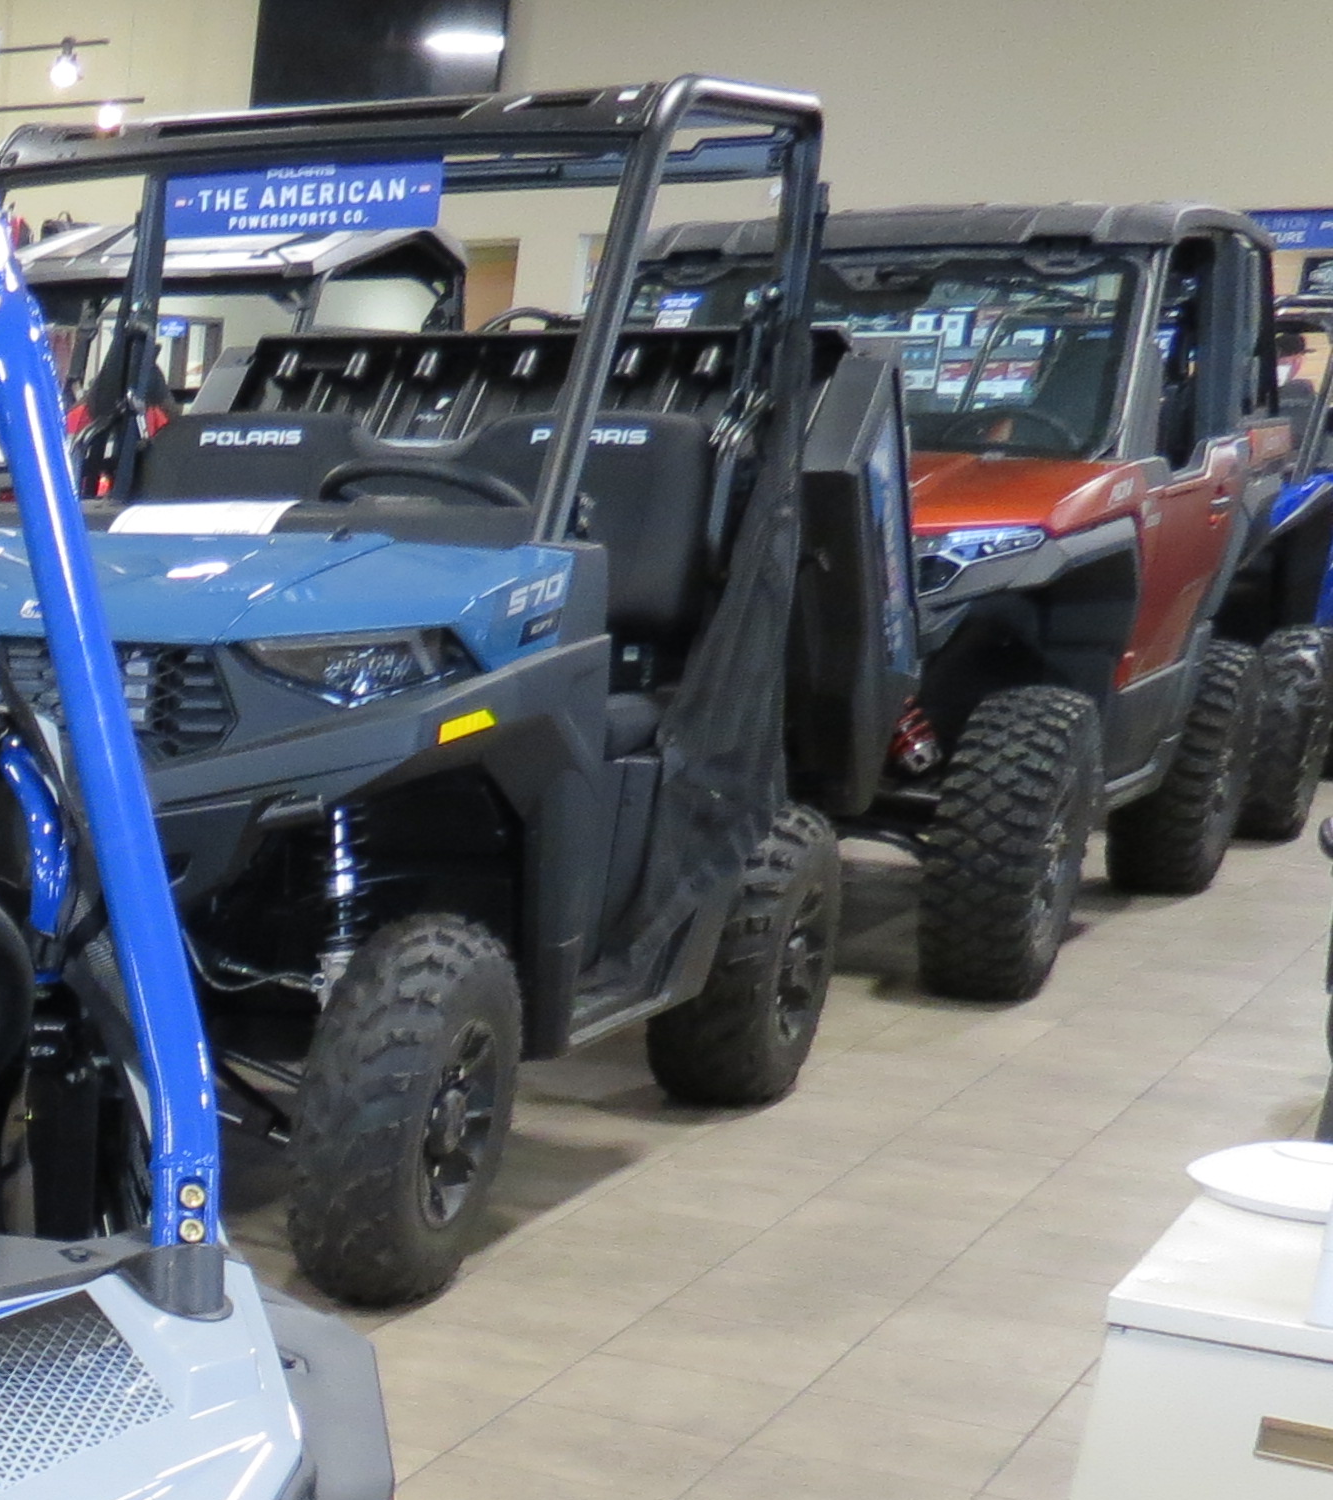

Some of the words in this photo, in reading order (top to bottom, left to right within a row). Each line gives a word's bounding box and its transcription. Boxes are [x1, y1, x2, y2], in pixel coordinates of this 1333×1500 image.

[198, 187, 250, 213] THE
[259, 178, 407, 209] AMERICAN
[228, 210, 337, 231] POWERSPORTS
[200, 428, 303, 447] POLARIS
[530, 428, 648, 446] PARIS
[506, 572, 566, 618] 570
